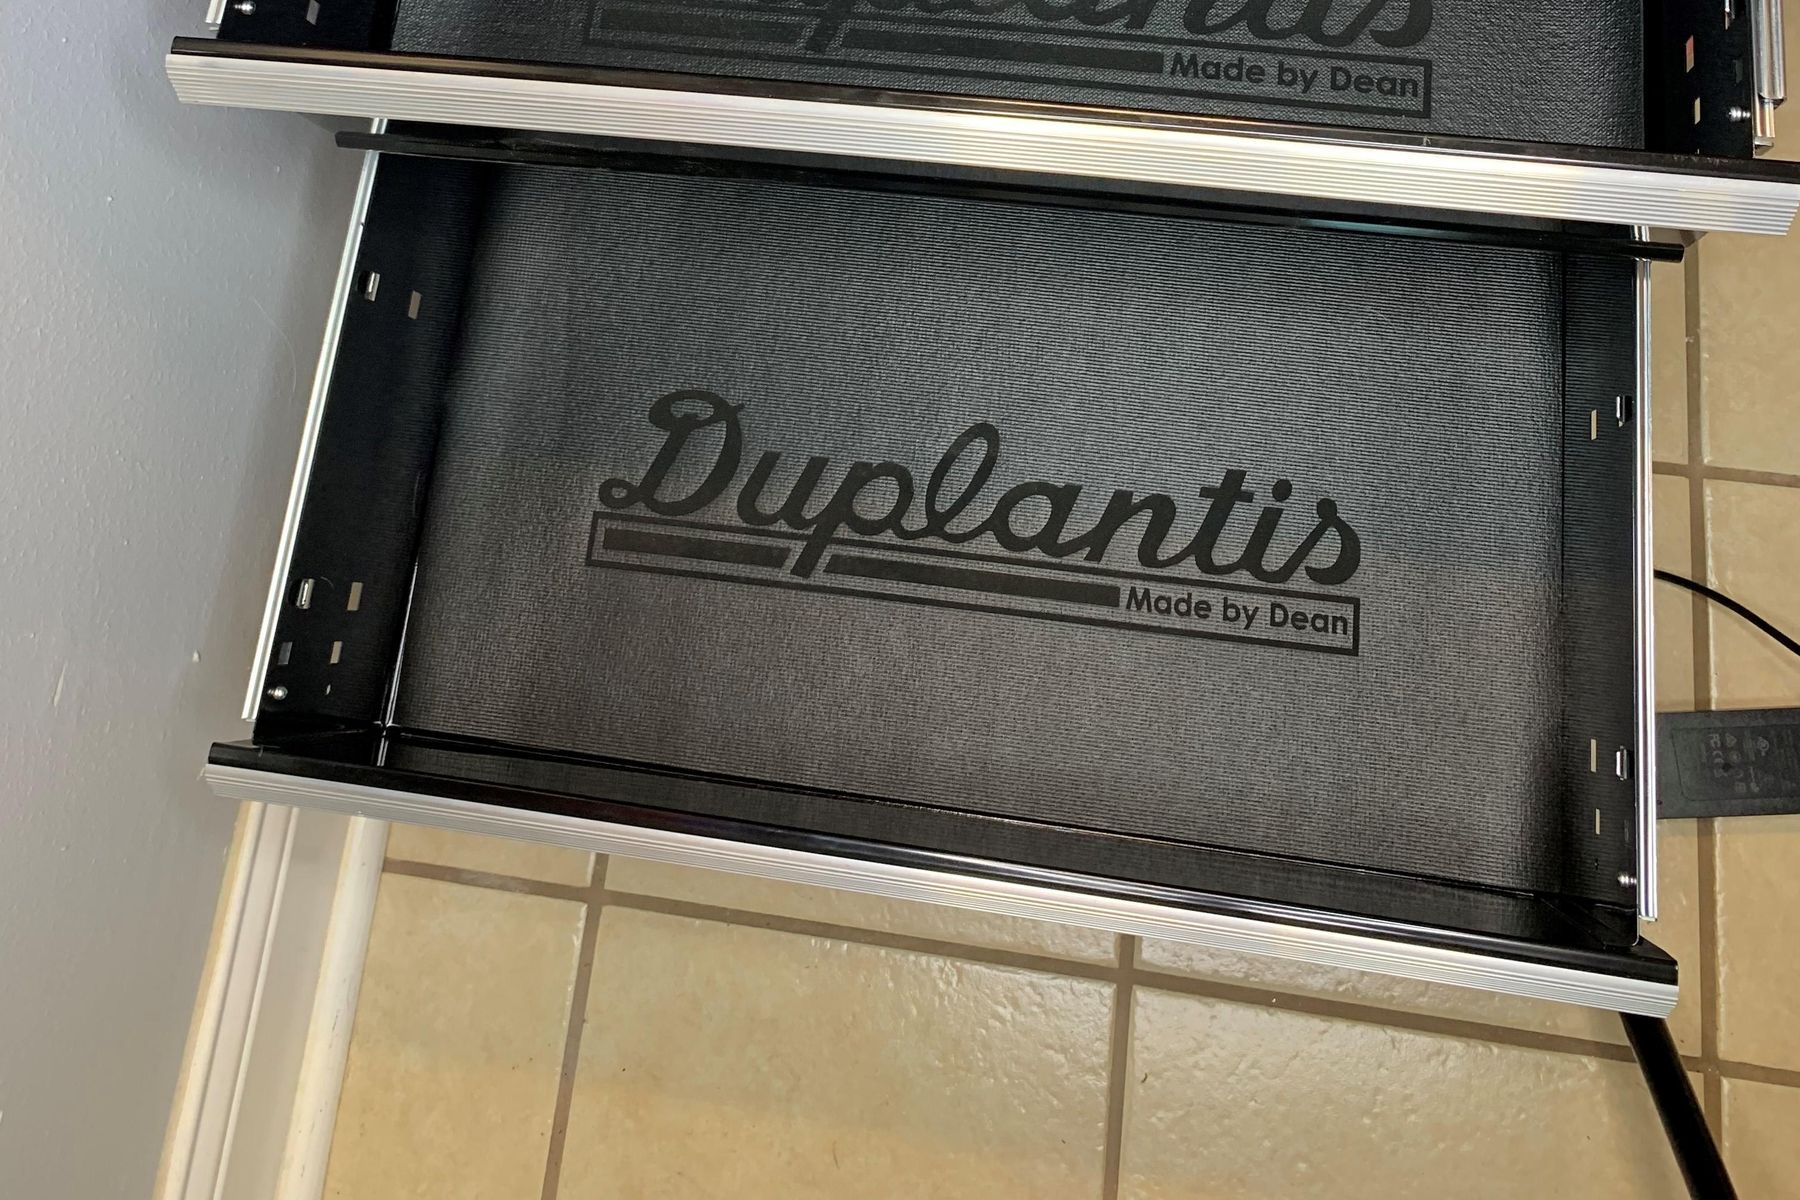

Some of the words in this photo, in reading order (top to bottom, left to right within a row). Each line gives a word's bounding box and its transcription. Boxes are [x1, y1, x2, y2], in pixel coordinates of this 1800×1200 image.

[1170, 52, 1266, 84] Made
[1277, 60, 1319, 94] by
[1330, 65, 1419, 98] Dean
[599, 389, 1362, 585] Duplantis
[1126, 586, 1212, 619] Made
[1222, 596, 1260, 630] by
[1269, 601, 1349, 636] Dean
